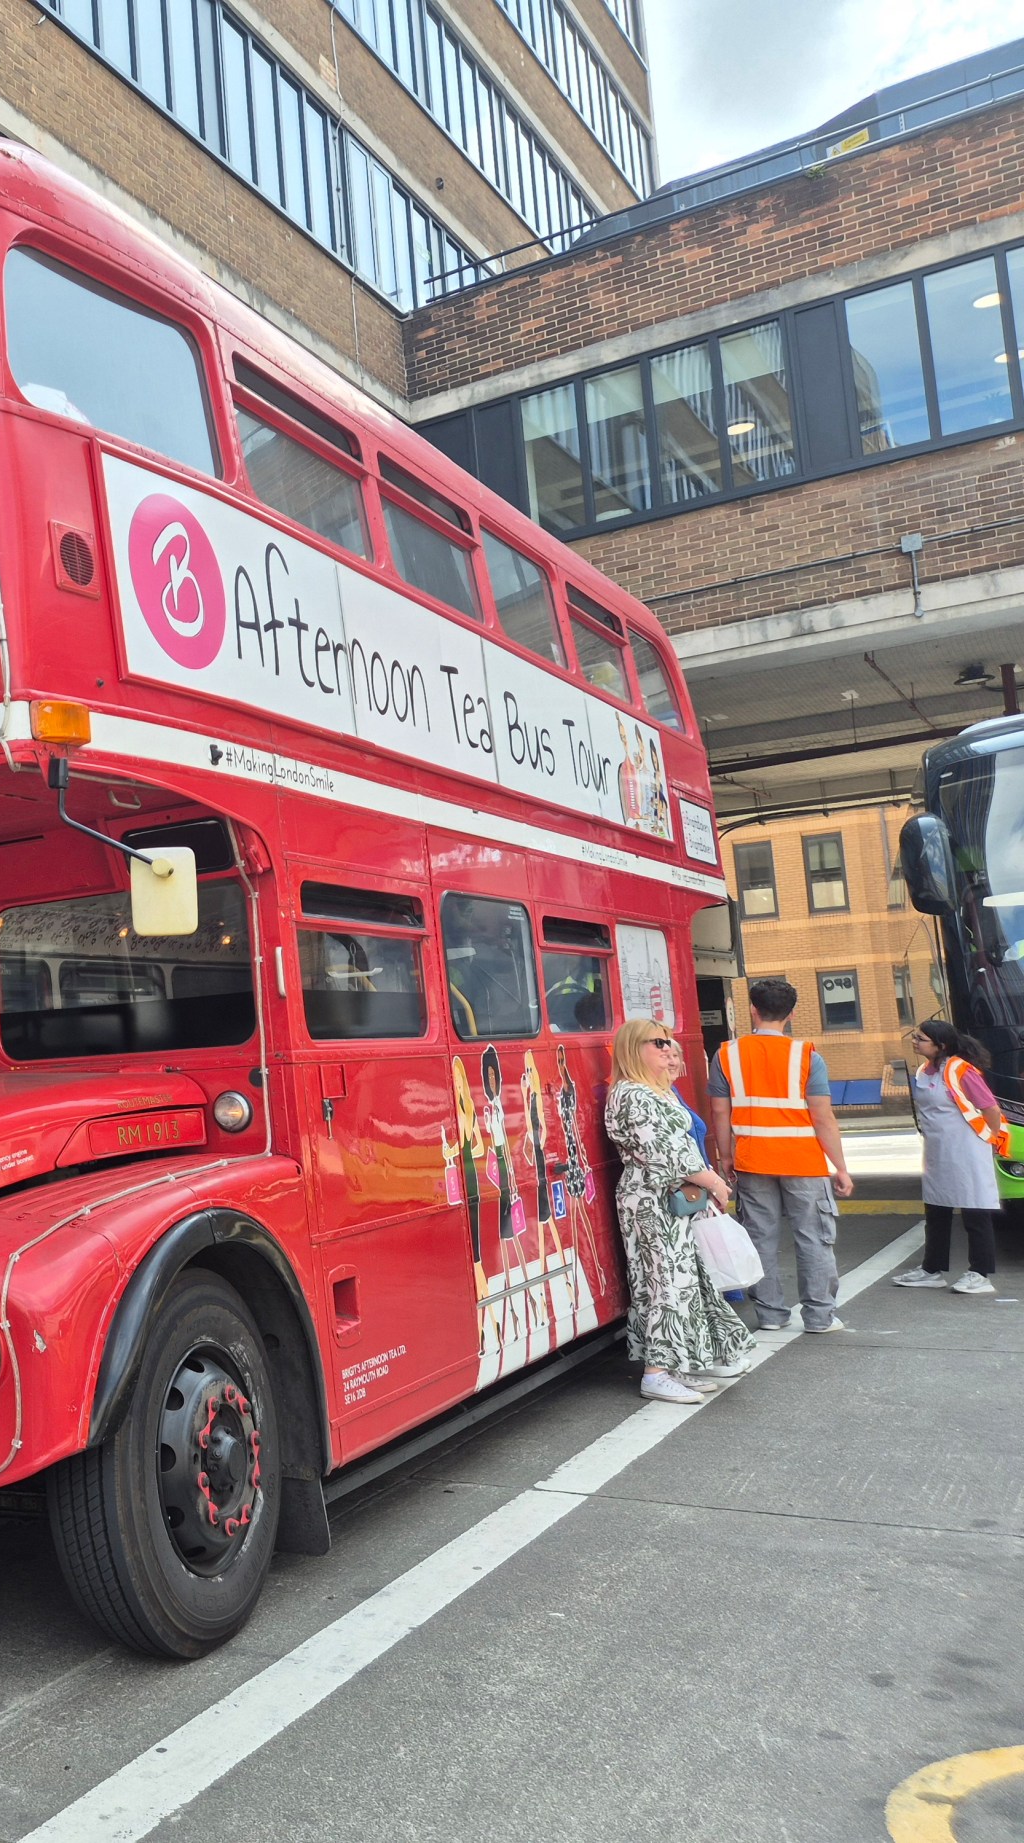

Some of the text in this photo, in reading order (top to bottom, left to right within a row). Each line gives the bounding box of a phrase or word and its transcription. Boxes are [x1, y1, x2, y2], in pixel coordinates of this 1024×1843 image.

[234, 542, 611, 795] Afternoon Tea Bus Tour
[226, 746, 334, 792] #MakingLondonSmile
[117, 1119, 180, 1146] RM 1913
